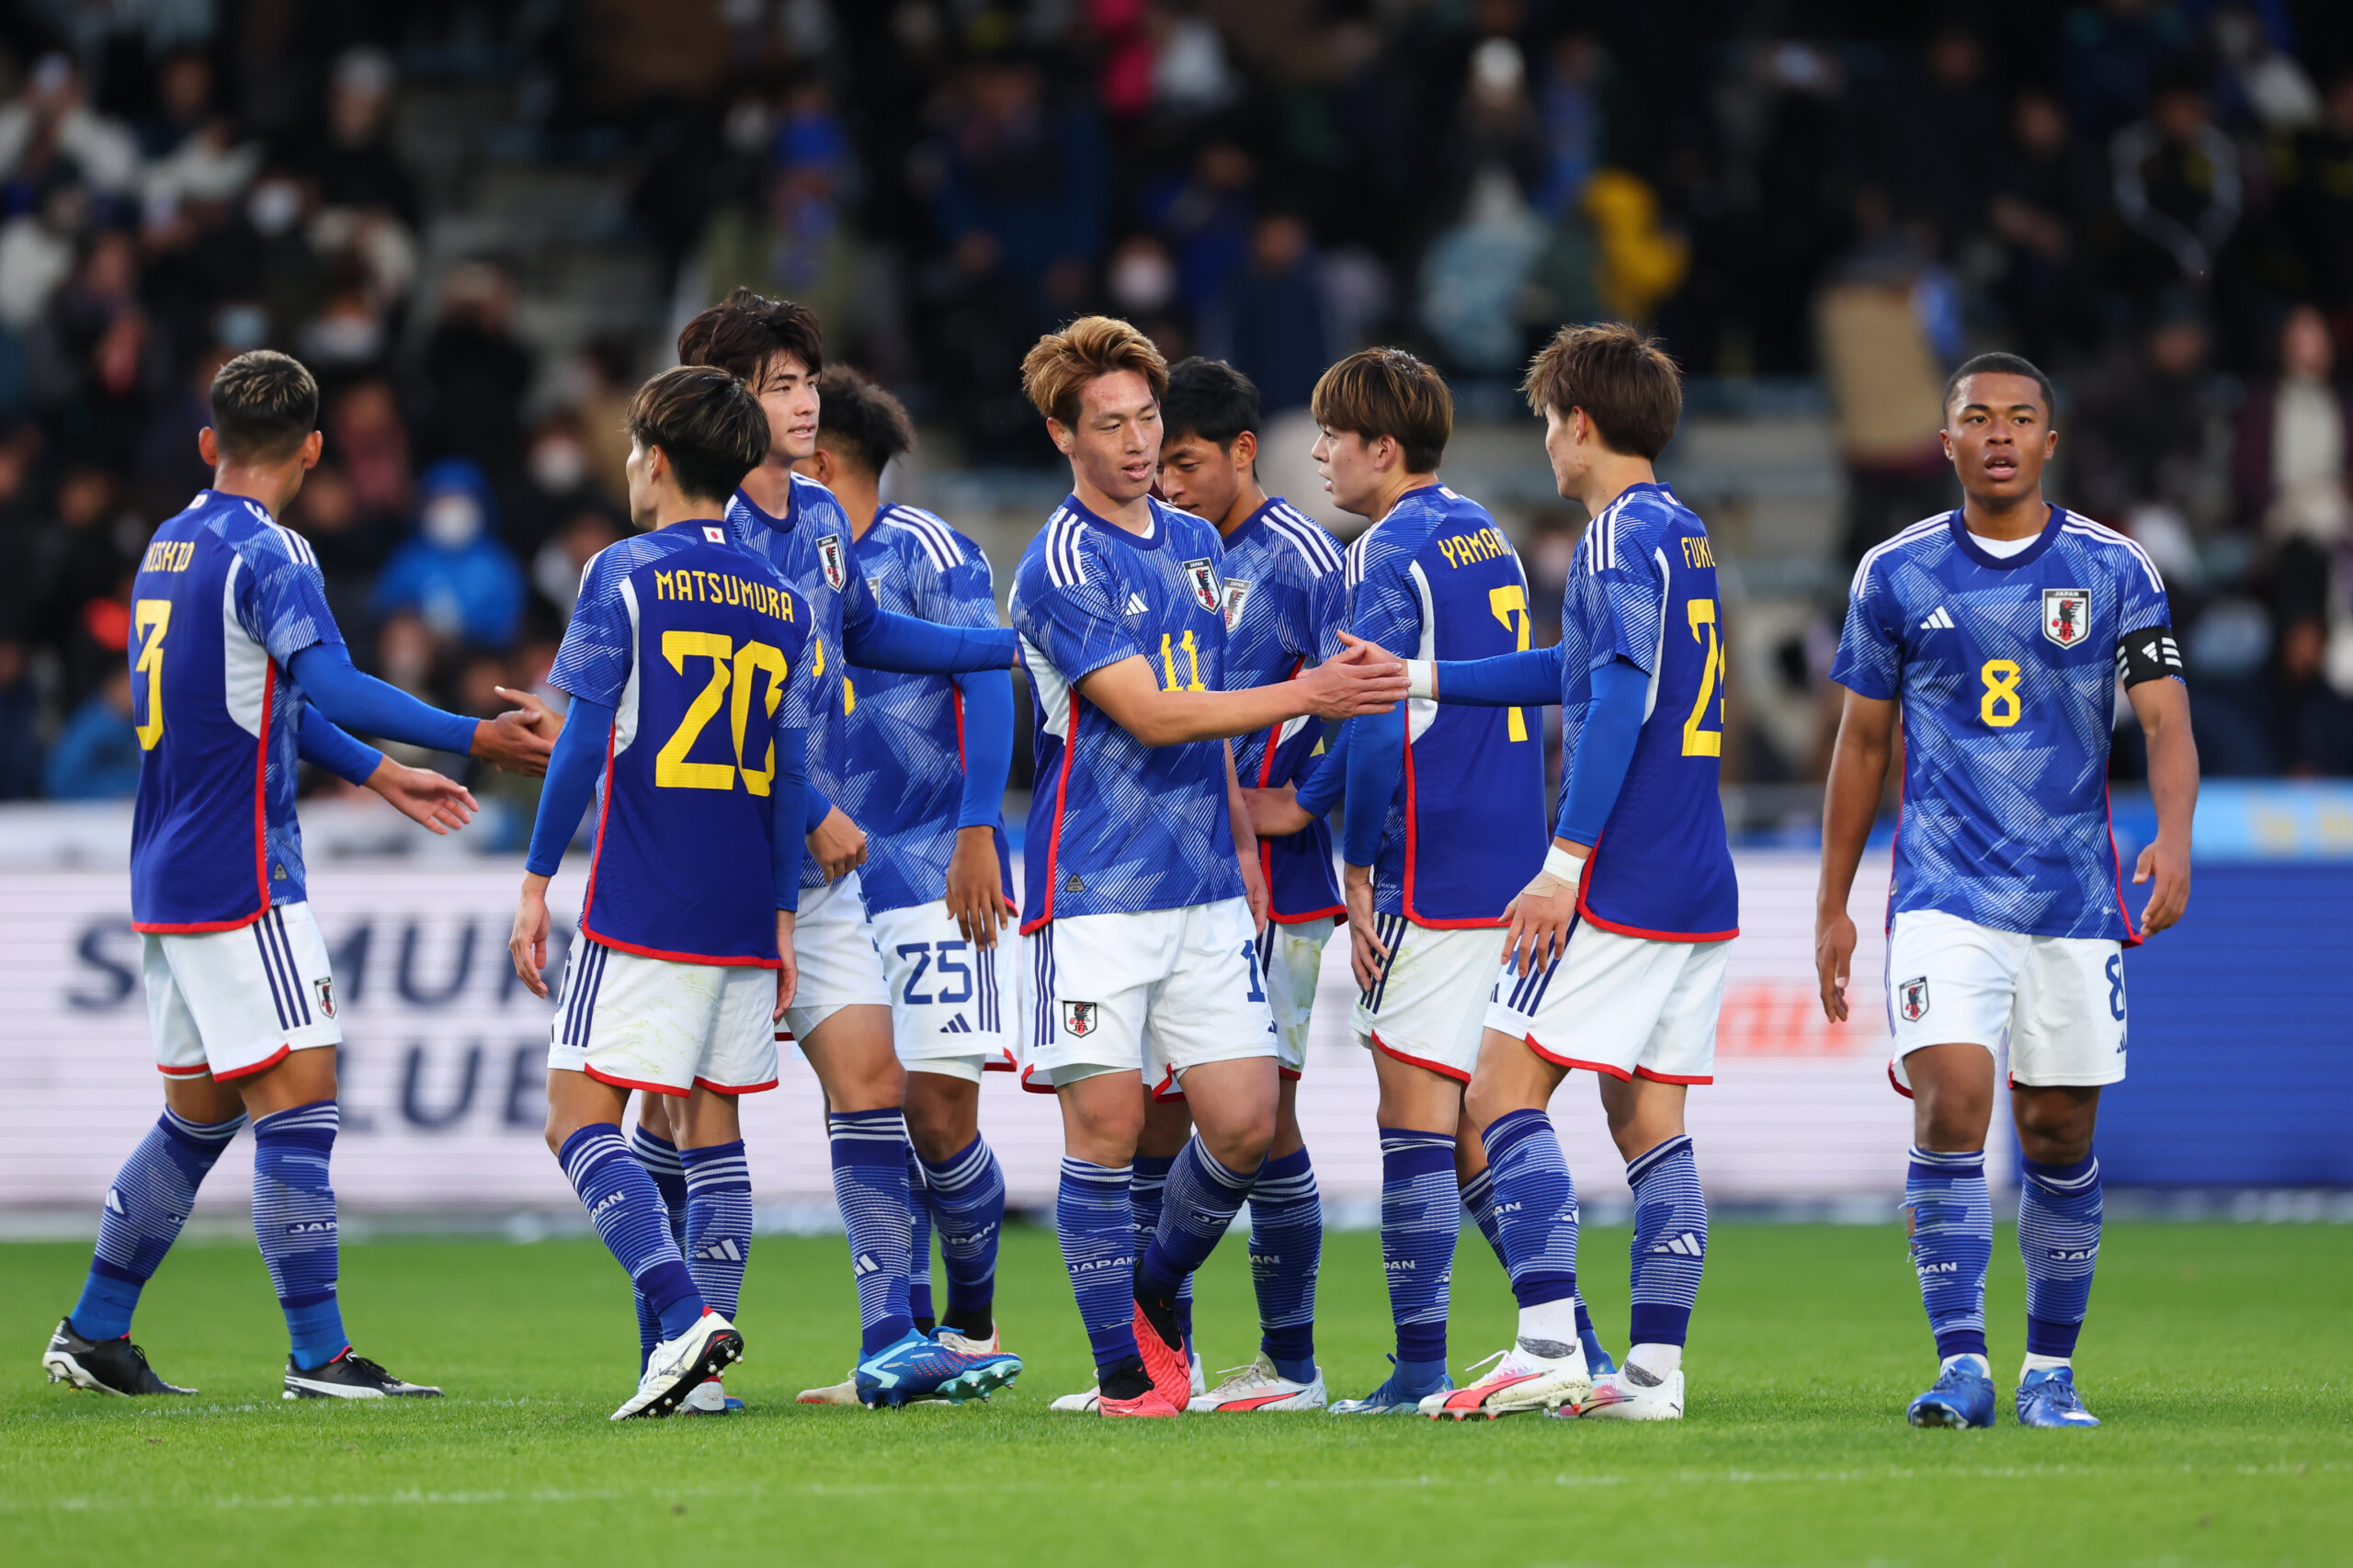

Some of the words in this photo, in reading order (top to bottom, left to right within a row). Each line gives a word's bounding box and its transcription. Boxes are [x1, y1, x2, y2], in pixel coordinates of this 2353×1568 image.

[654, 569, 794, 623] MATSUMURA
[135, 599, 172, 751] 3
[1160, 630, 1206, 692] 11
[1488, 585, 1530, 743] 7
[1681, 598, 1726, 757] 2
[1981, 659, 2021, 727] 8
[655, 630, 788, 797] 20
[896, 939, 973, 1005] 25
[2105, 952, 2126, 1022] 8
[1069, 1256, 1133, 1274] JAPAN
[1382, 1260, 1415, 1269] PAN
[1916, 1262, 1958, 1276] PAN
